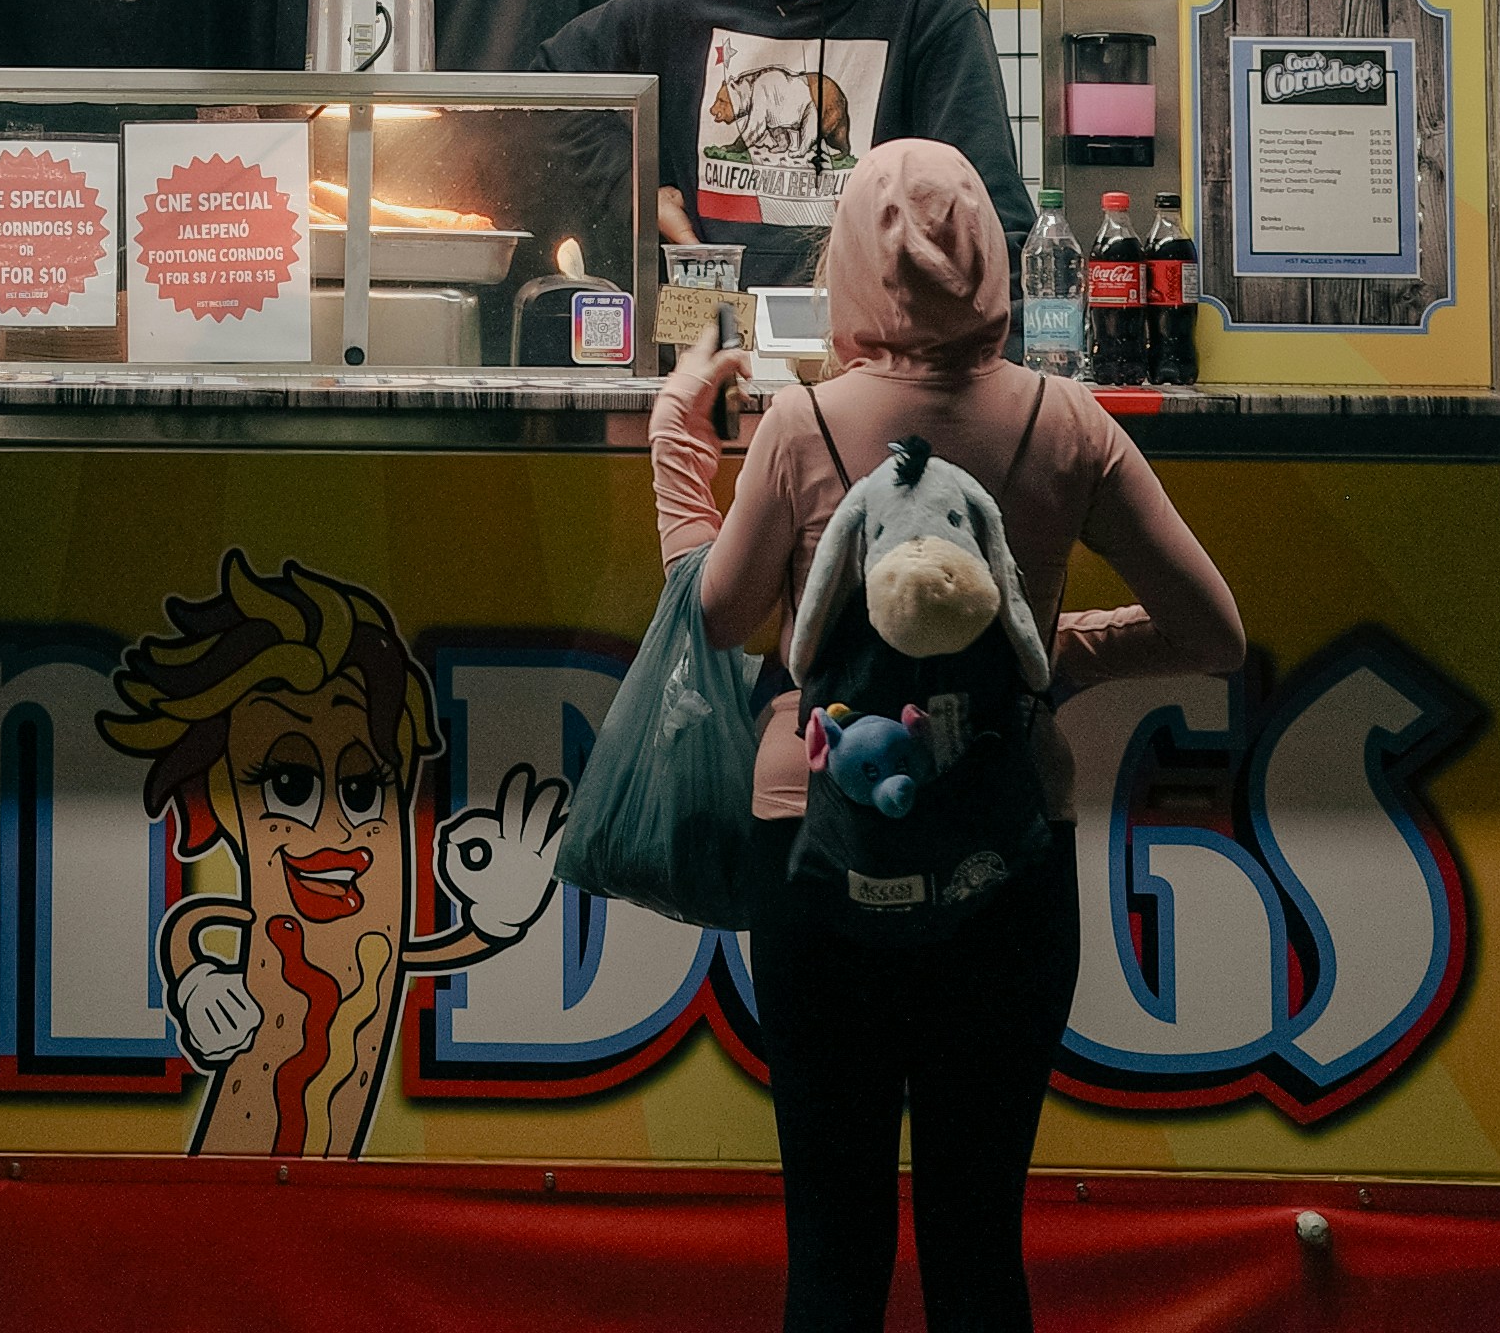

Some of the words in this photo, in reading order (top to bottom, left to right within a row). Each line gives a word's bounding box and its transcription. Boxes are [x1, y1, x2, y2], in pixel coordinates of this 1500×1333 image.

[705, 162, 784, 195] CALIFORNIA
[788, 172, 852, 197] REPUBLI
[9, 189, 85, 209] SPECIAL
[155, 194, 194, 213] CNE
[198, 191, 274, 212] SPECIAL
[76, 221, 94, 237] $6
[19, 244, 34, 257] OR
[148, 249, 217, 264] FOOTLONG
[219, 246, 284, 263] CORNDOG
[0, 267, 34, 285] FOR
[38, 267, 68, 285] $10
[157, 272, 164, 286] 1
[165, 271, 190, 285] FOR
[192, 271, 208, 285] $8
[219, 270, 227, 285] 2
[229, 269, 253, 284] FOR
[255, 269, 276, 284] $15
[425, 633, 1470, 1118] DGS
